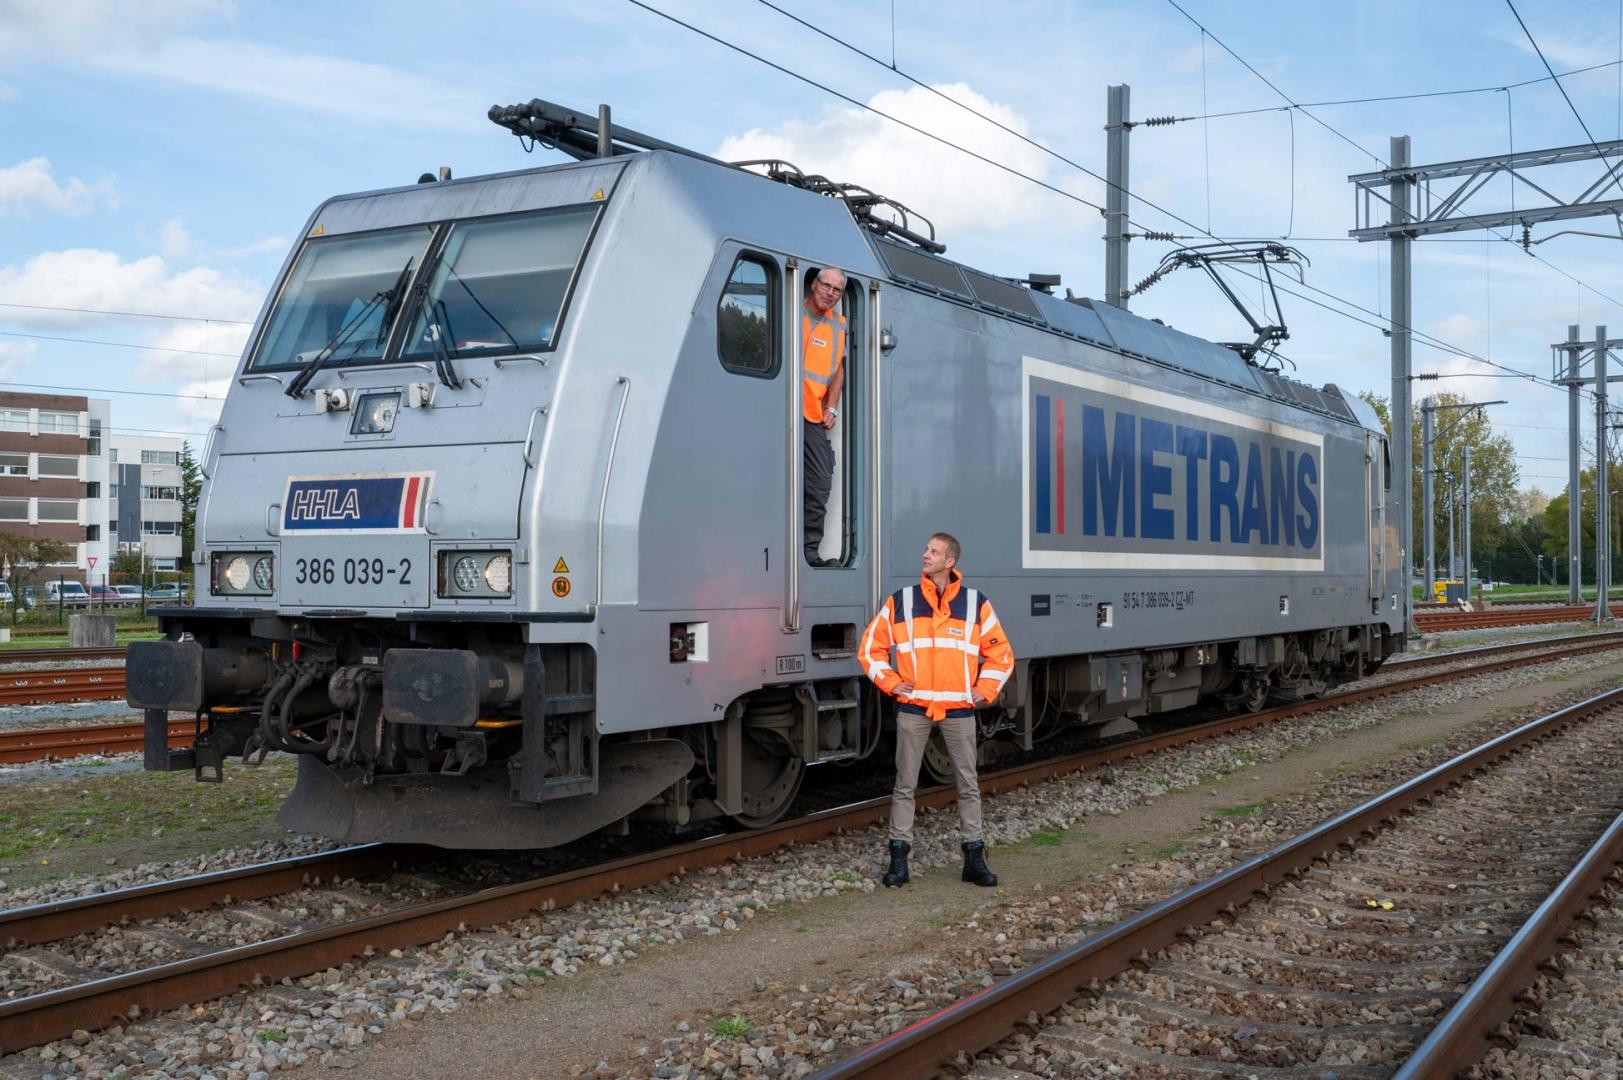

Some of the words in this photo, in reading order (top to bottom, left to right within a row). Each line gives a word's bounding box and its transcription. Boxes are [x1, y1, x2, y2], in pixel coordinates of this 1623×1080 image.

[1082, 404, 1319, 550] METRANS
[291, 488, 360, 520] HHLA
[296, 558, 335, 585] 386
[344, 558, 411, 585] 039-2
[763, 547, 769, 572] 1
